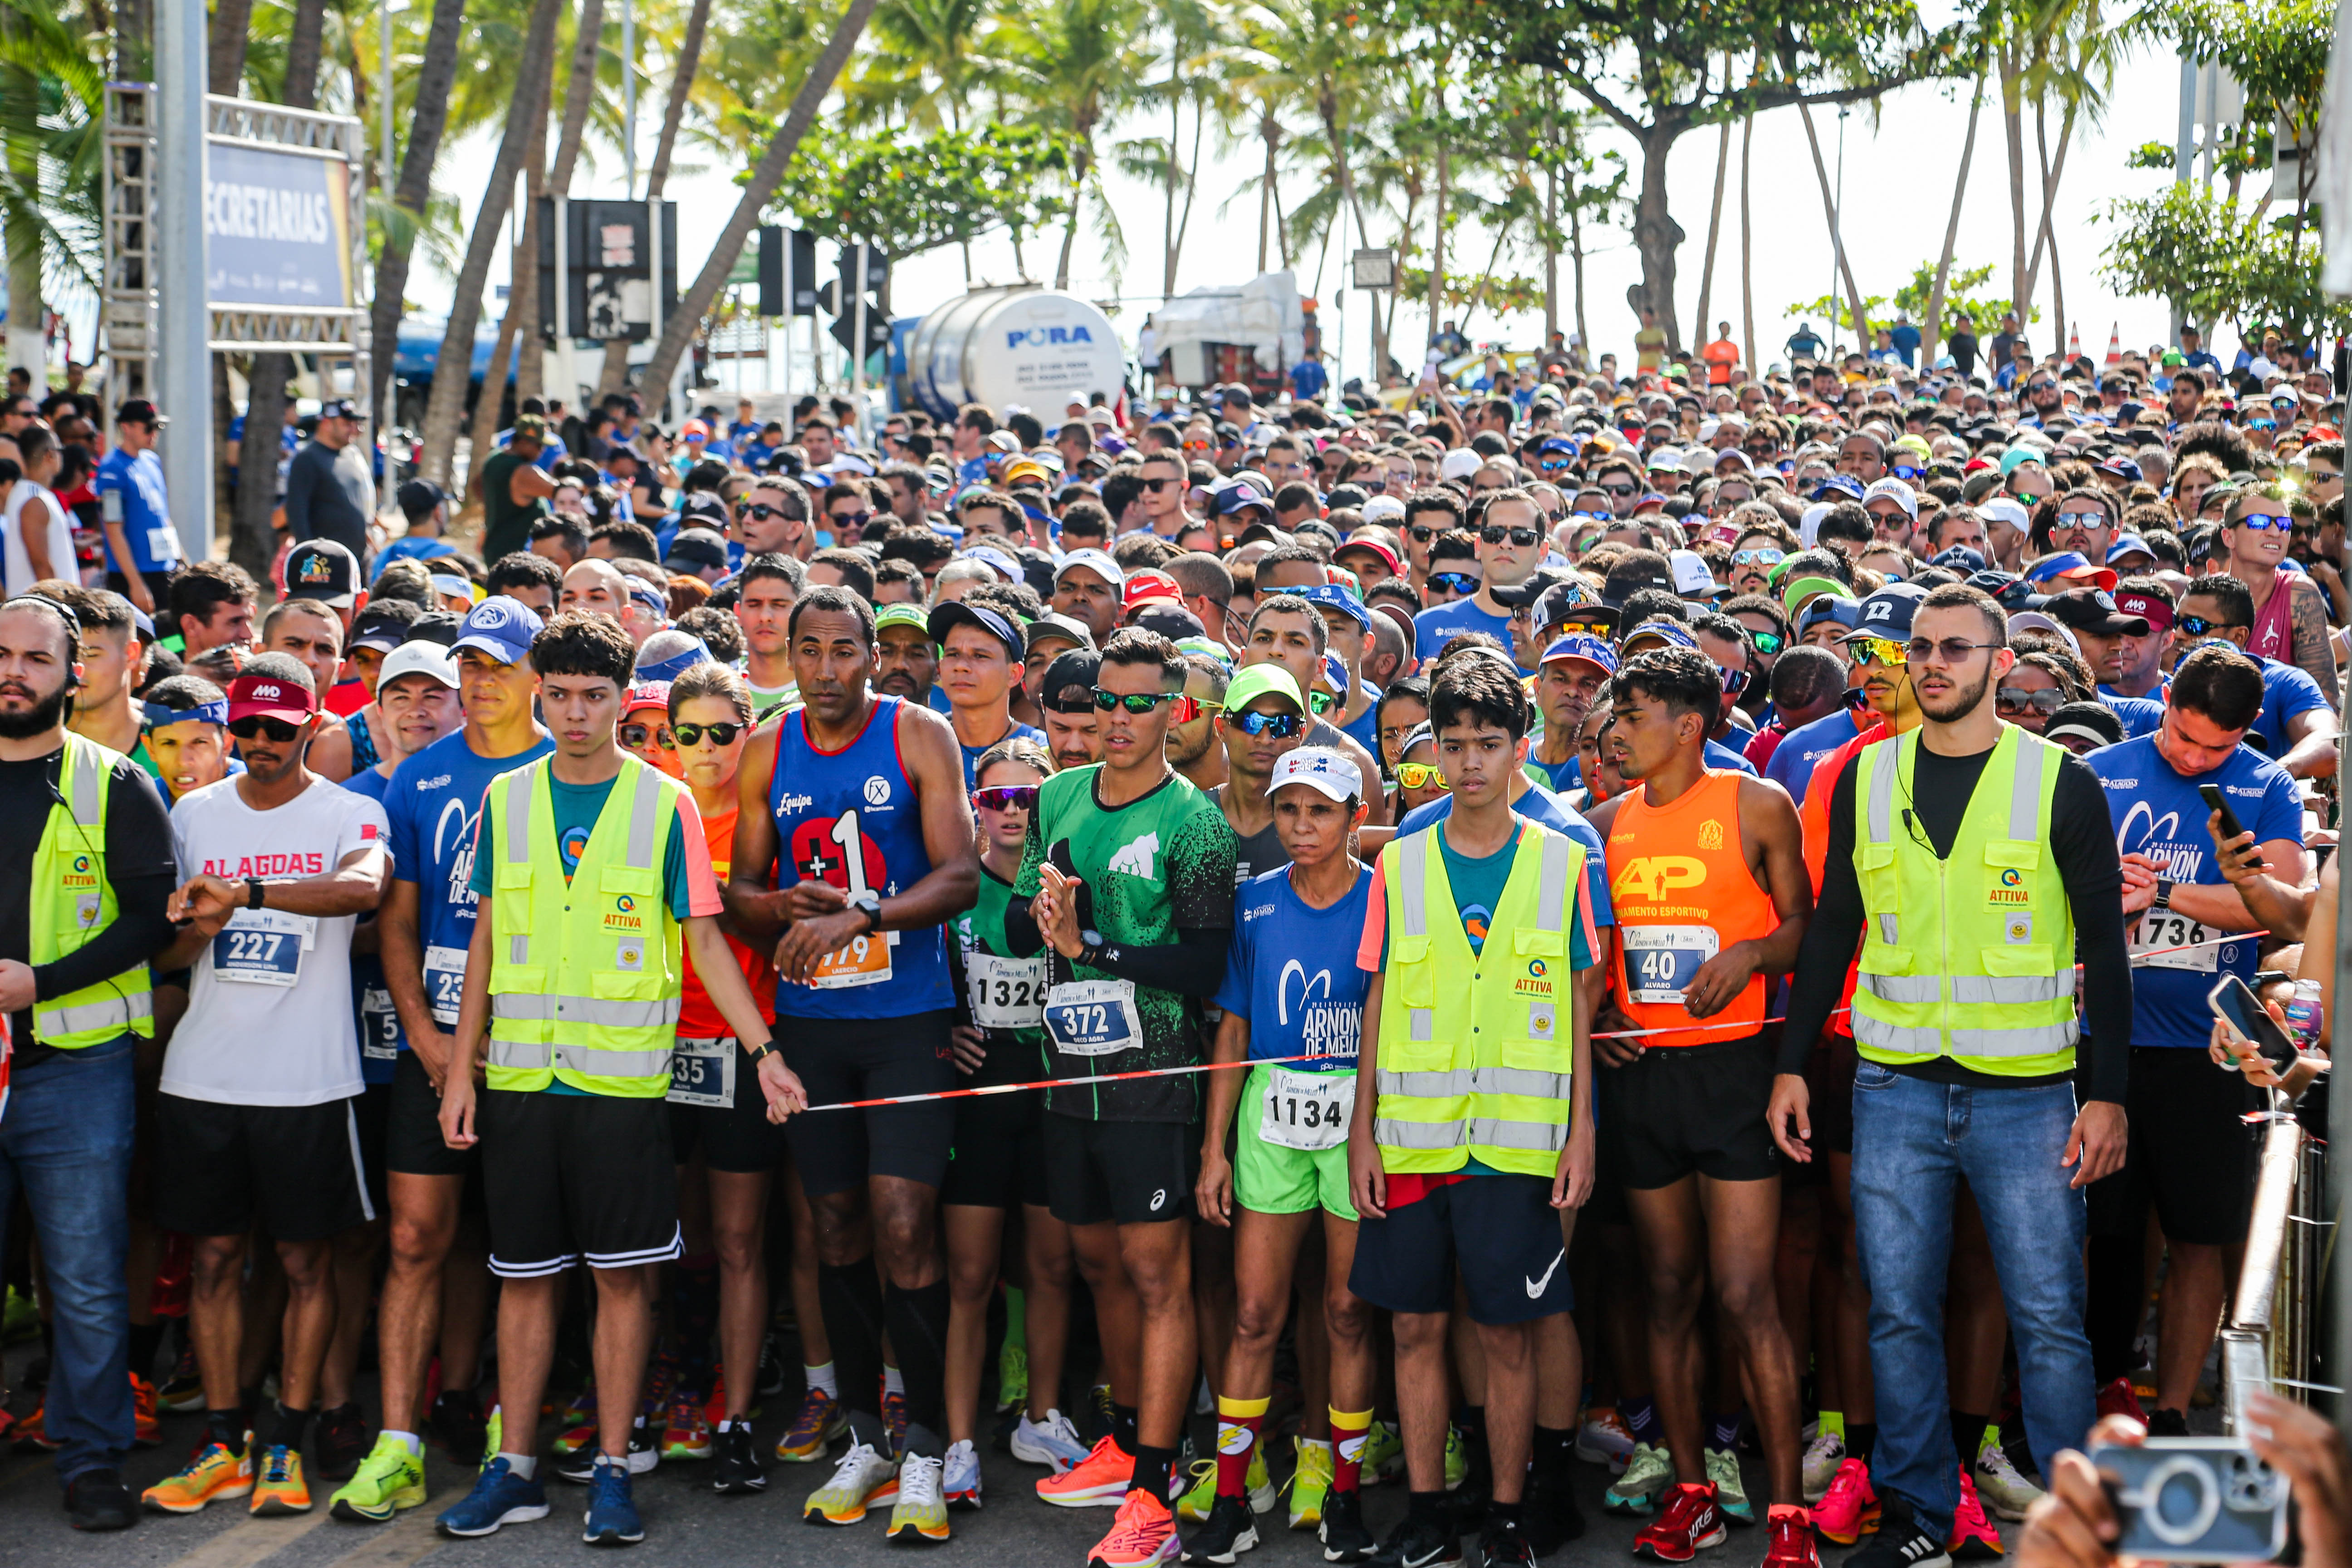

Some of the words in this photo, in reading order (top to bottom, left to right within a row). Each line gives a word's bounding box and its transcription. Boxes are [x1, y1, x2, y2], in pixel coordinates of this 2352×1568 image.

[776, 792, 813, 818] Equipe
[204, 853, 323, 879] ALAGOAS
[1989, 889, 2029, 902] ATTIVA
[604, 913, 642, 929] ATTIVA
[1660, 906, 1709, 920] ESPORTIVO
[228, 931, 283, 962] 227
[1634, 938, 1649, 947] ARNON
[1652, 937, 1666, 947] MELLO
[1641, 951, 1677, 981] 40
[1515, 979, 1553, 995] ATTIVA
[1319, 1000, 1357, 1009] CIRCUITO
[1062, 1004, 1109, 1036] 372
[1302, 1007, 1362, 1039] ARNON
[1088, 1035, 1106, 1043] AGRA
[1305, 1036, 1324, 1062] DE
[671, 1057, 705, 1084] 35
[1286, 1086, 1299, 1094] ARNON
[1303, 1088, 1318, 1096] MELLO
[1270, 1094, 1342, 1128] 1134
[1529, 1287, 1542, 1297] NIKE
